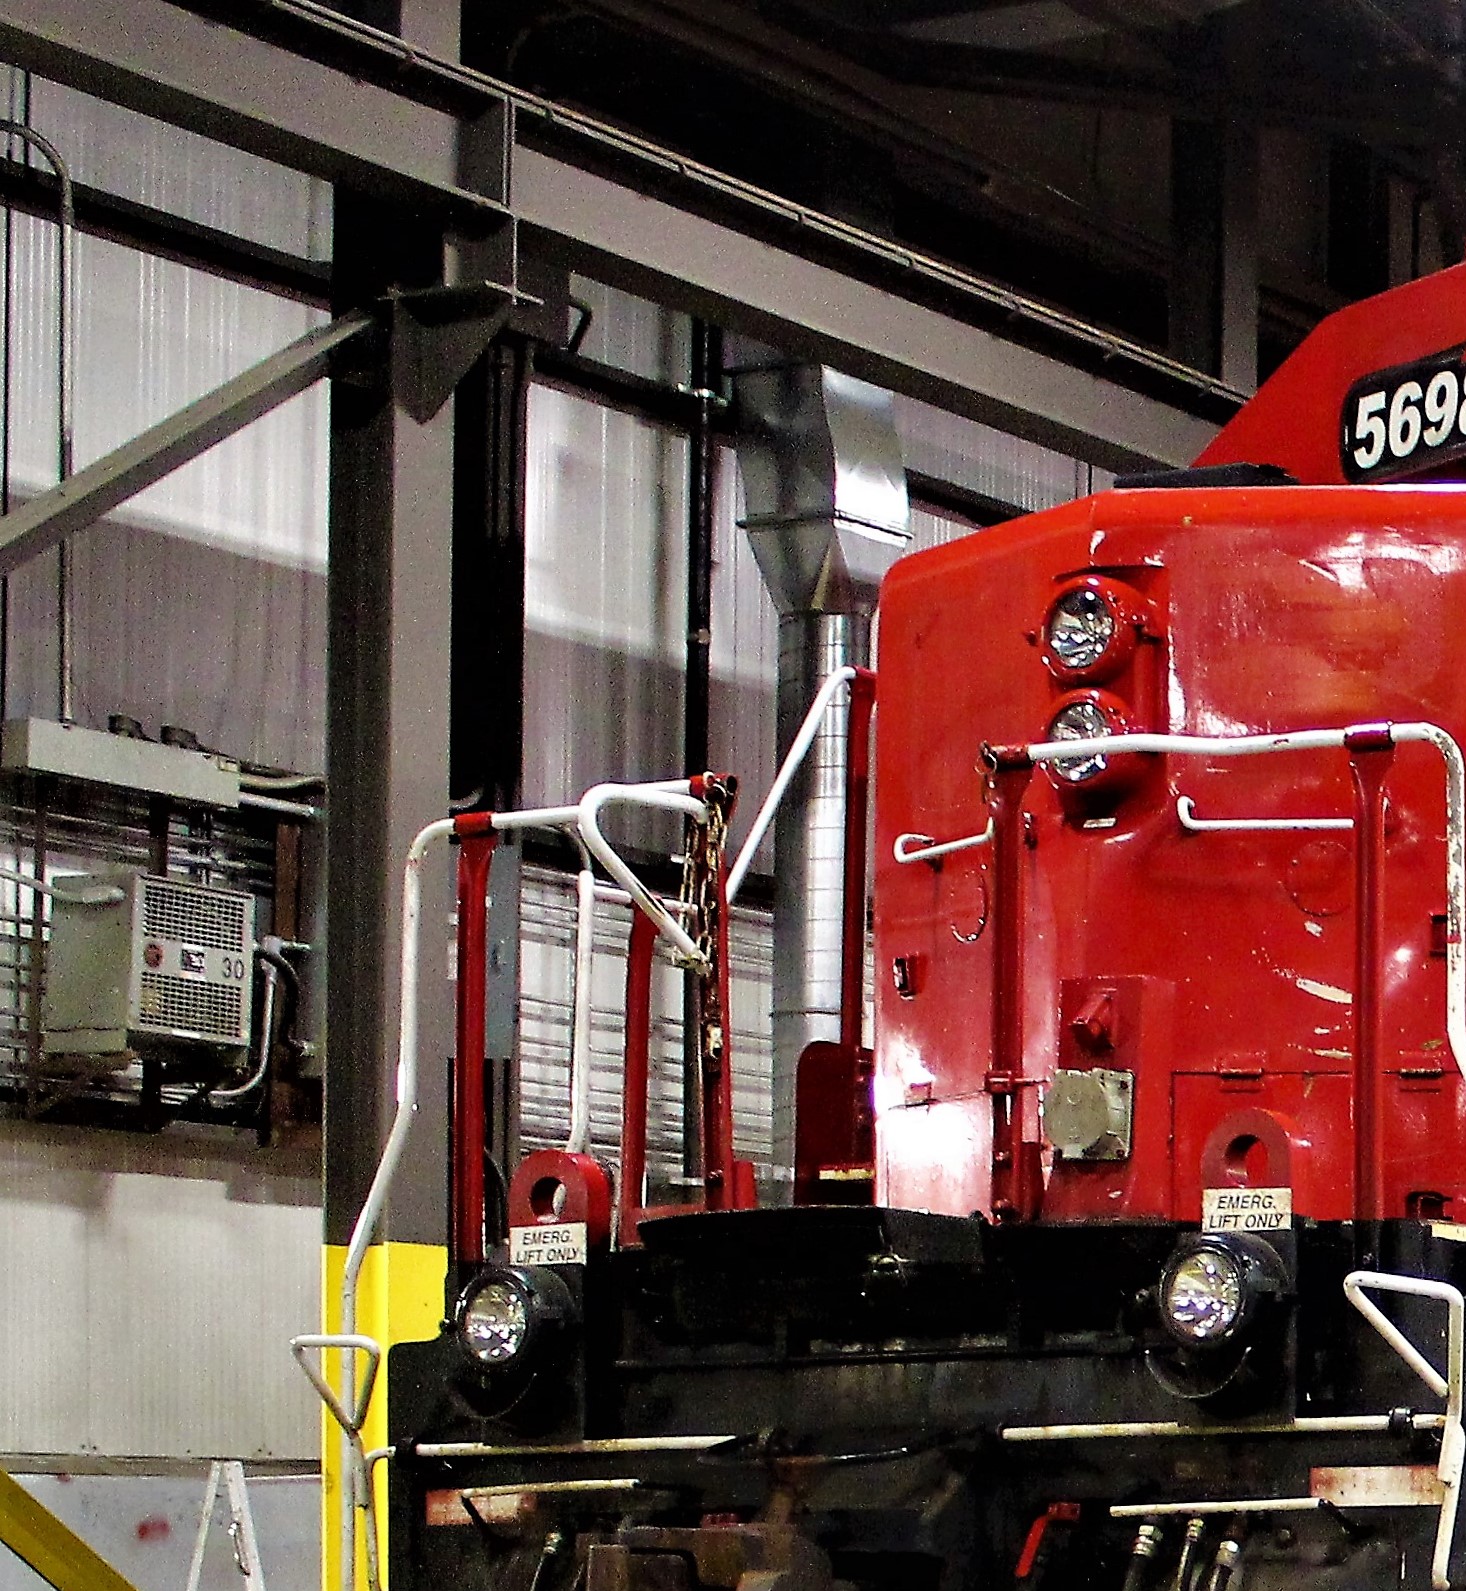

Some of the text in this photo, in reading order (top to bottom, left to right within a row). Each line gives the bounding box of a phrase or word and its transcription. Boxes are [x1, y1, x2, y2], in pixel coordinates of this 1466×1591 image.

[222, 957, 245, 979] 30
[1217, 1195, 1277, 1210] EMERG.
[1209, 1213, 1284, 1229] LIFT ONLY
[522, 1229, 574, 1246] EMERG.
[516, 1247, 580, 1263] LIFT ONLY
